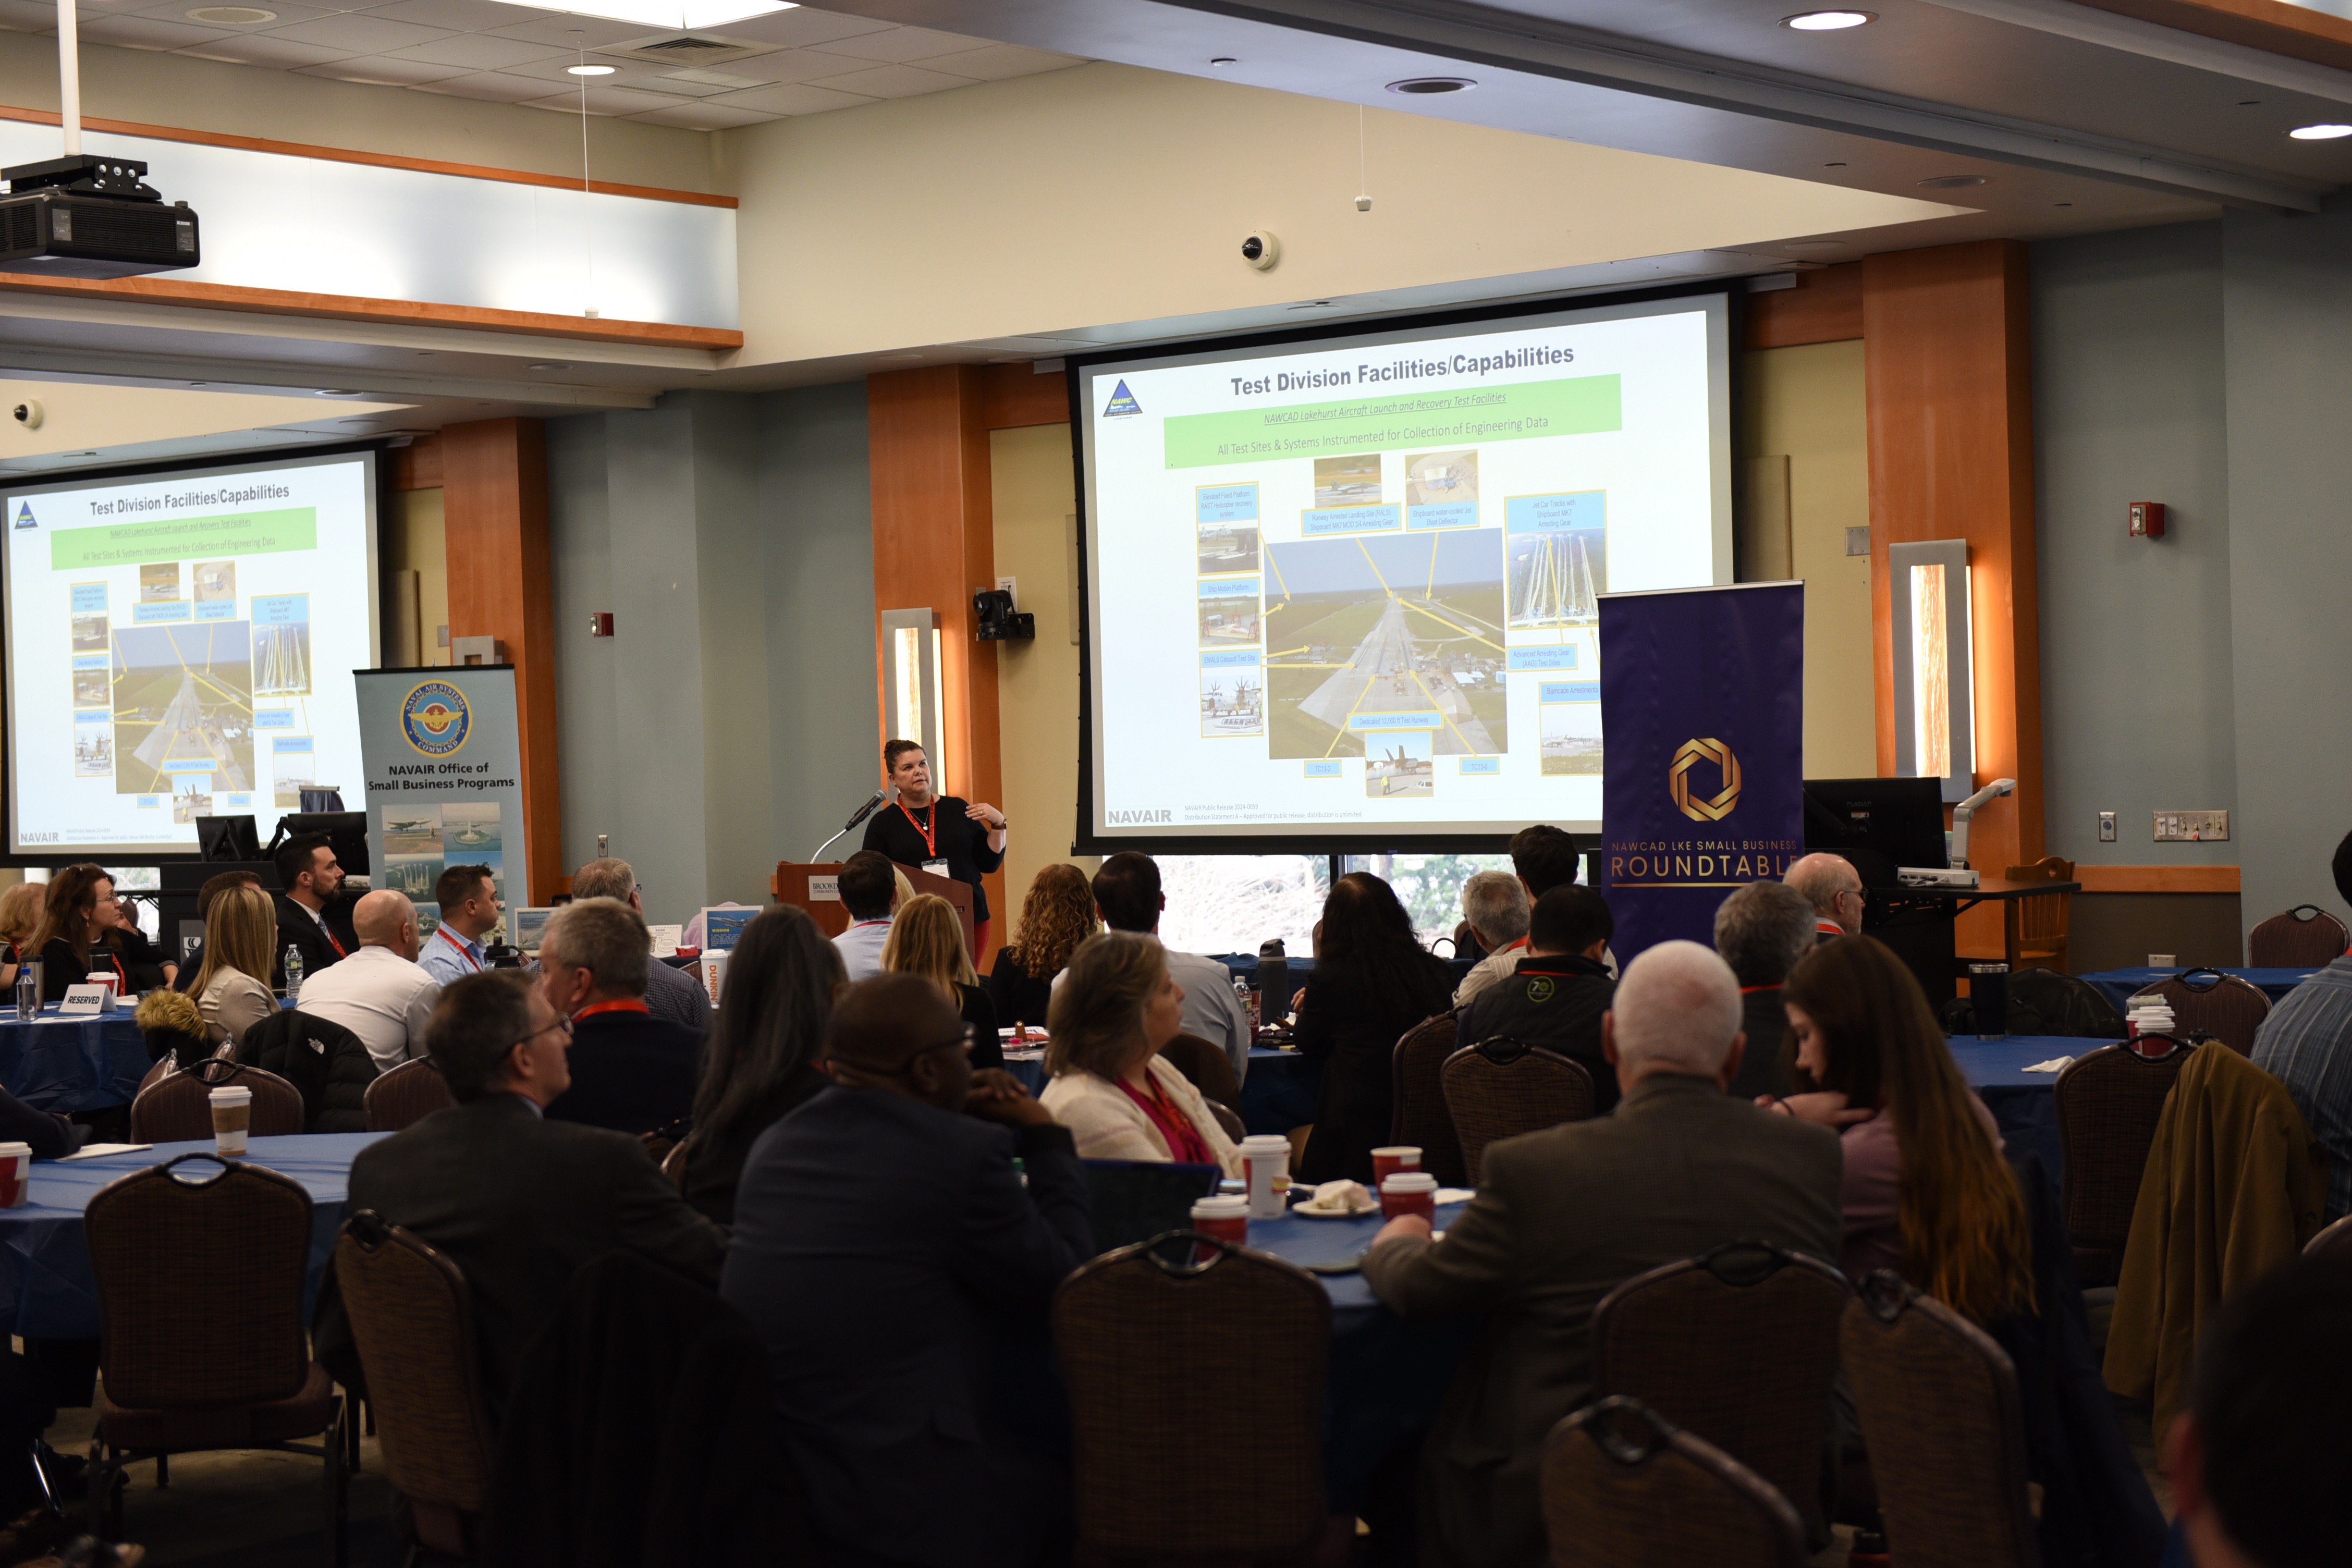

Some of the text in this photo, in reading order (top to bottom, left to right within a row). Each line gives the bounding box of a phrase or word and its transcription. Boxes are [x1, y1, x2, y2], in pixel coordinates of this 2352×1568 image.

[1231, 345, 1574, 396] Test Division Facilities/Capabilities
[1264, 392, 1507, 425] NAWCAD Lakehurst Aircraft Launch and Recovery Test Facilities
[1218, 416, 1549, 456] All Test Sites & Systems Instrumented for Collection of Engineering Data
[91, 484, 289, 515] Test Division Facilities/Capabilities
[1536, 510, 1560, 519] Shipboard
[1538, 520, 1559, 529] Arresting
[91, 552, 101, 560] Test
[102, 550, 115, 559] Sites
[121, 548, 143, 560] Systems
[144, 545, 180, 555] Instrumented
[191, 542, 219, 552] Collection
[227, 538, 260, 551] Engineering
[262, 537, 275, 546] Data
[406, 687, 424, 710] NAVAL
[439, 684, 466, 710] SYSTEMS
[418, 740, 458, 753] COMMAND
[389, 763, 489, 775] NAVAIR Office of
[369, 778, 514, 790] Small Business Programs
[1108, 810, 1171, 823] NAVAIR
[20, 832, 58, 842] NAVAIR
[1612, 840, 1796, 851] NAWCAD LKE SMALL BUSINESS
[68, 996, 100, 1004] RESERVED
